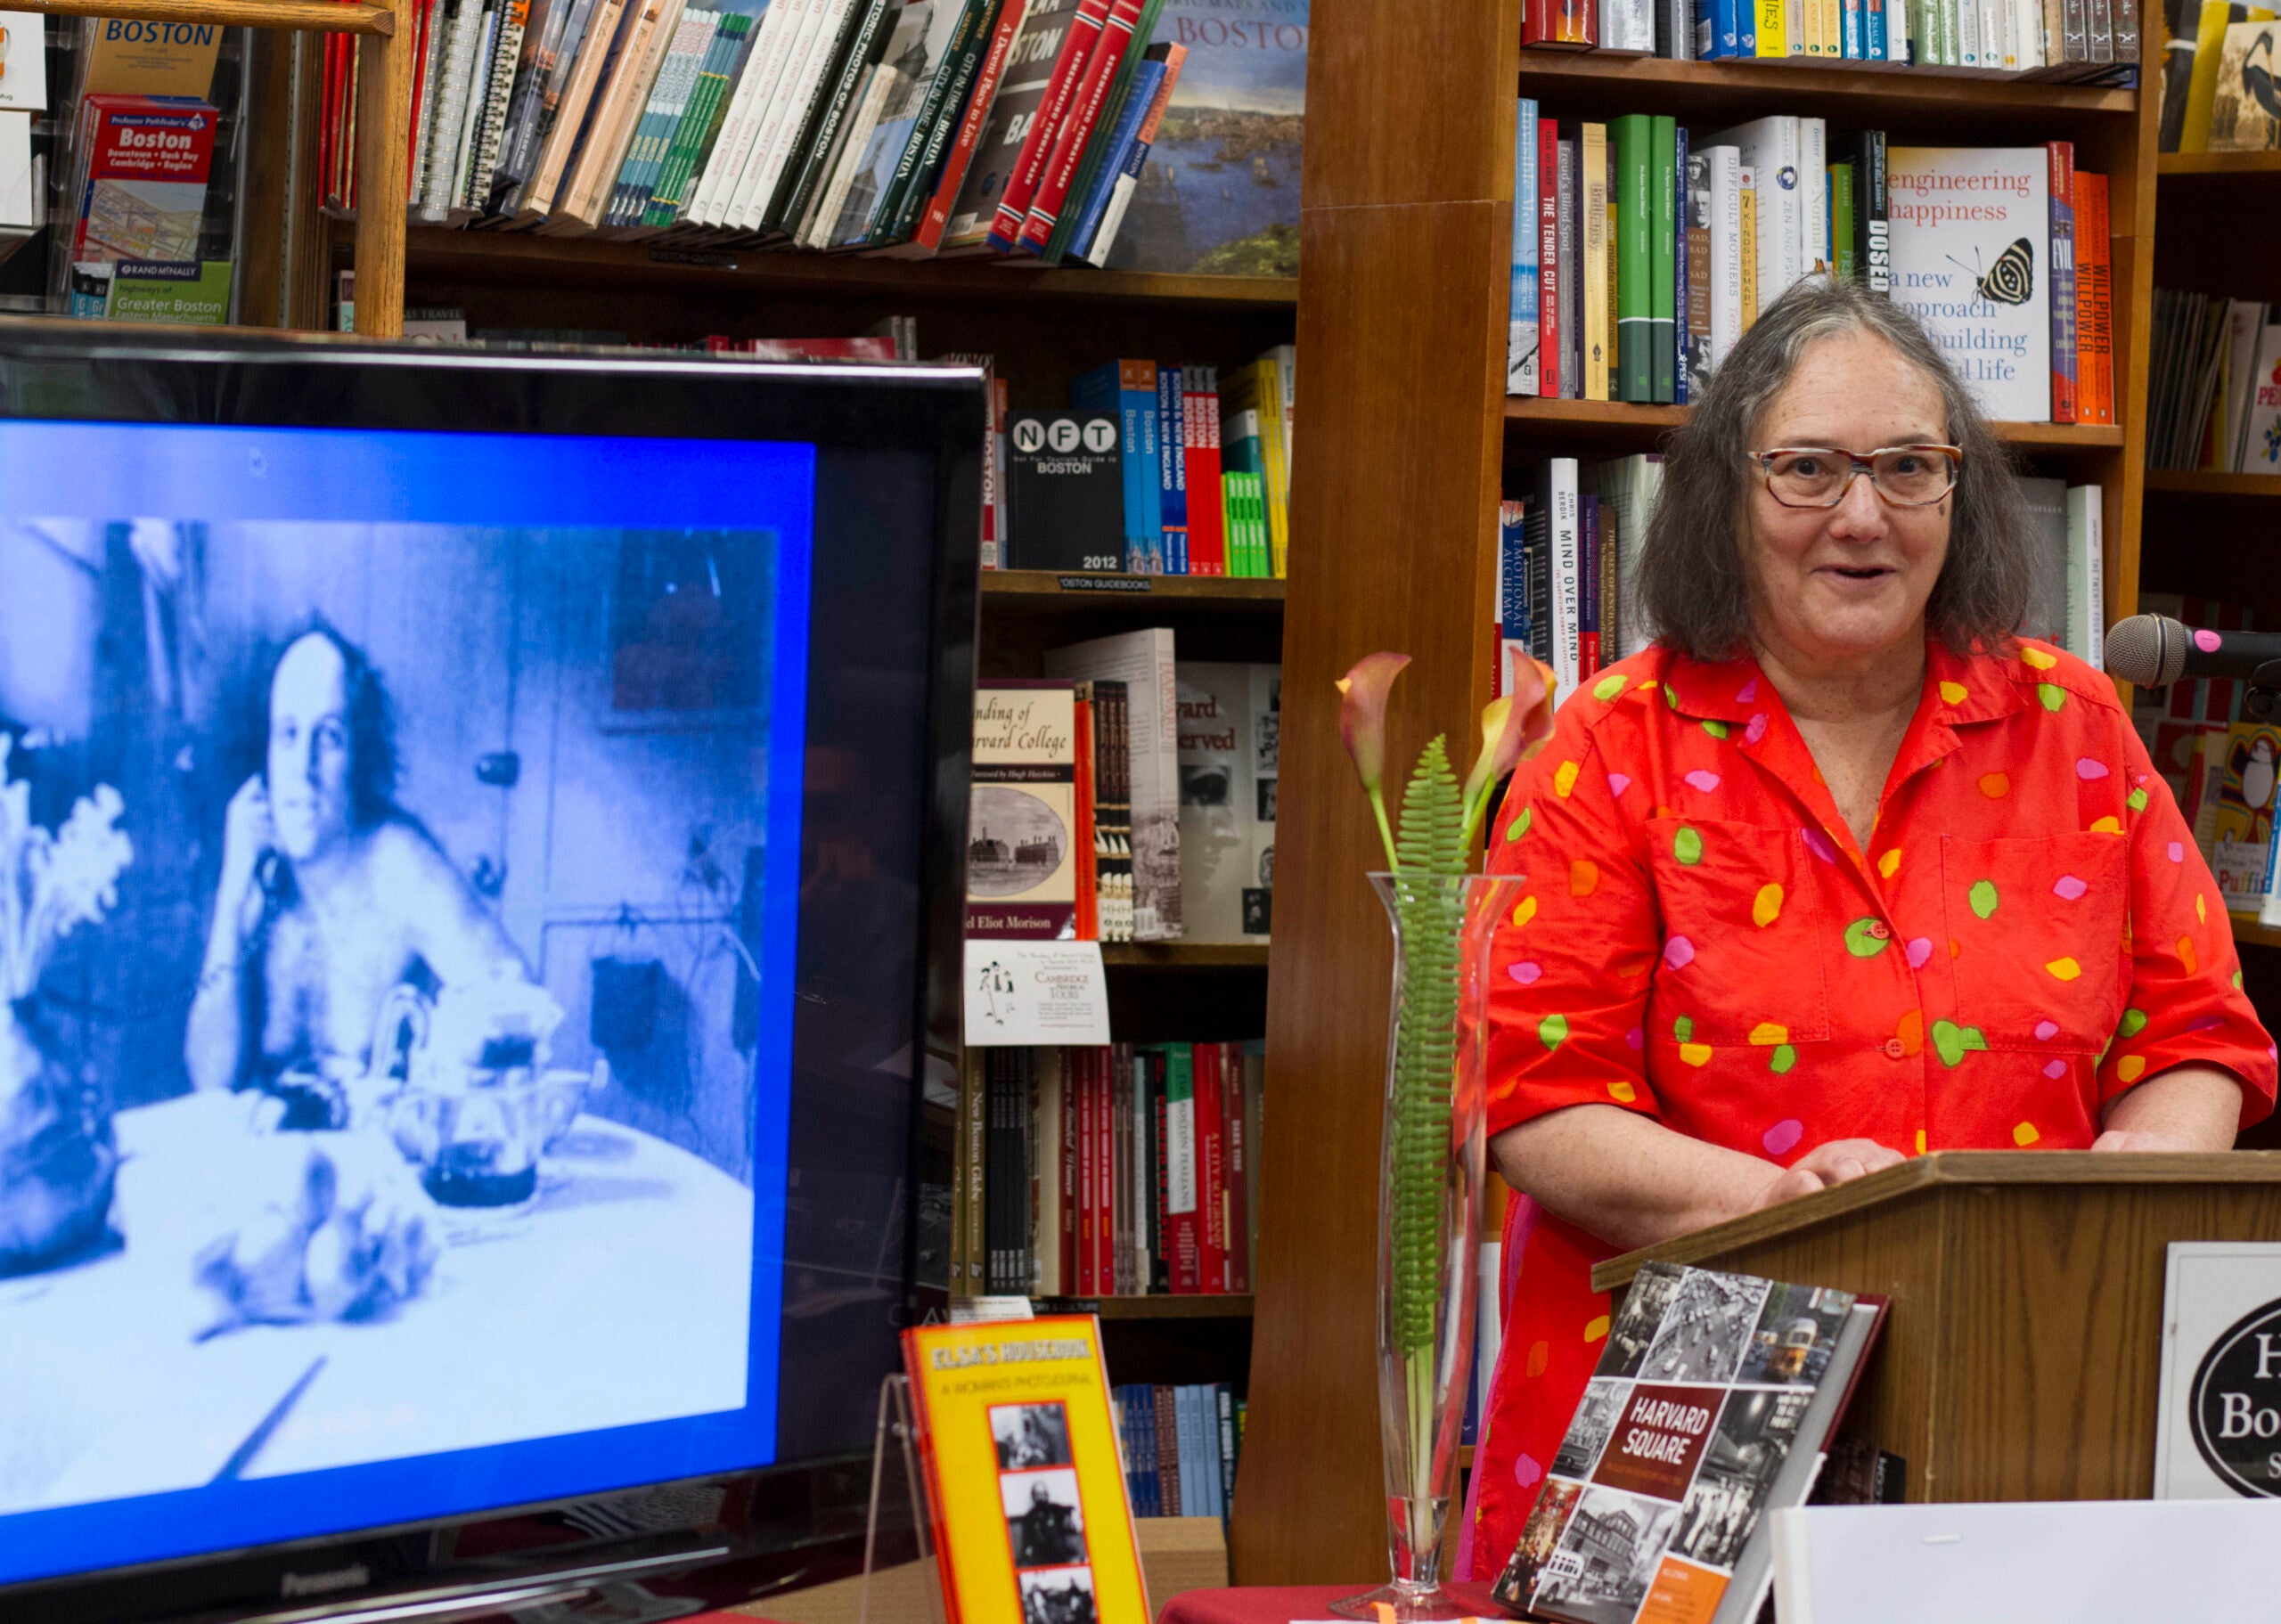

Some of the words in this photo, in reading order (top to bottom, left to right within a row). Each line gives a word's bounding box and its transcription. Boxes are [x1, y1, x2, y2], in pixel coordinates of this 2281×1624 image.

[106, 20, 214, 46] BOSTON
[951, 11, 974, 52] HANTOVER
[1001, 22, 1013, 35] A
[842, 41, 868, 90] PHOTOS
[959, 51, 977, 76] CITY
[985, 35, 1009, 76] Decent
[934, 63, 952, 88] CITY
[953, 75, 968, 89] IN
[1050, 50, 1084, 120] REMEMBERING
[1083, 53, 1117, 124] REMEMBERING
[835, 90, 848, 108] OF
[928, 87, 943, 102] IN
[944, 88, 962, 114] TIME
[973, 76, 993, 106] Place
[918, 101, 936, 127] TIME
[968, 107, 981, 121] to
[119, 127, 192, 149] Boston
[814, 110, 840, 159] BOSTON
[922, 118, 950, 168] BOSTON
[958, 121, 976, 147] Live
[1034, 120, 1055, 159] FENWAY
[1066, 124, 1088, 163] FENWAY
[1544, 130, 1553, 150] ADLER
[1812, 127, 1820, 157] Better
[107, 149, 151, 159] Downtown
[160, 151, 180, 159] Back
[182, 151, 199, 162] Bay
[895, 130, 924, 180] BOSTON
[1128, 142, 1148, 176] BOSTON
[1520, 110, 1536, 190] Invisible
[110, 158, 155, 170] Cambridge
[163, 160, 193, 172] Region
[1023, 159, 1039, 185] PARK
[1056, 163, 1072, 189] PARK
[1559, 147, 1570, 189] Freud's
[1727, 157, 1737, 228] DIFFICULT
[1887, 170, 2031, 197] engineering
[1520, 197, 1533, 234] Men
[1543, 196, 1554, 217] THE
[1559, 192, 1570, 224] Blind
[1742, 195, 1751, 208] 7
[1783, 201, 1793, 223] ZEN
[1888, 200, 2007, 227] happiness
[1742, 211, 1751, 253] KINDS
[1811, 189, 1824, 249] Normal
[1543, 223, 1554, 265] TENDER
[1559, 227, 1570, 251] Spot
[1688, 234, 1710, 243] MAD,
[1689, 247, 1707, 255] BAD
[1783, 227, 1793, 252] AND
[1729, 233, 1737, 296] MOTHERS
[1868, 219, 1889, 292] DOSED
[2052, 238, 2073, 271] EVIL
[132, 265, 157, 274] RAND
[1543, 270, 1554, 291] CUT
[1689, 272, 1707, 280] SAD
[1888, 272, 1900, 287] a
[1906, 272, 1953, 288] new
[119, 283, 160, 294] highways
[162, 285, 172, 293] of
[1742, 270, 1752, 309] SMART
[117, 296, 170, 312] Greater
[174, 298, 222, 313] Boston
[1607, 289, 1615, 349] mindfulness
[2079, 262, 2094, 353] WILLPOWER
[2095, 263, 2111, 355] WILLPOWER
[1929, 329, 2028, 356] building
[1677, 361, 1686, 379] PESI
[1978, 359, 2015, 381] life
[1158, 371, 1168, 408] BOSTON
[1173, 371, 1182, 409] BOSTON
[1160, 410, 1169, 419] &
[1173, 411, 1182, 419] &
[1182, 396, 1194, 447] BOSTON
[1195, 396, 1206, 448] BOSTON
[1207, 397, 1219, 449] BOSTON
[1125, 409, 1137, 453] Boston
[1143, 410, 1157, 454] Boston
[1160, 420, 1170, 443] NEW
[1174, 421, 1183, 444] NEW
[982, 430, 993, 504] BOSTON
[1037, 462, 1091, 474] BOSTON
[1161, 445, 1172, 490] ENGLAND
[1175, 445, 1185, 490] ENGLAND
[1557, 490, 1566, 520] BERDIK
[1559, 529, 1573, 569] MIND
[1606, 528, 1615, 550] THE
[1083, 556, 1117, 568] 2012
[1606, 551, 1615, 573] USES
[2091, 558, 2099, 573] THE
[1094, 578, 1150, 590] GUIDEBOOKS
[1501, 547, 1513, 620] ALCHEMY
[1513, 539, 1523, 629] EMOTIONAL
[1563, 575, 1576, 616] OVER
[1607, 575, 1615, 589] OF
[2092, 576, 2100, 608] TWENTY
[2092, 611, 2100, 632] FOUR
[1566, 621, 1580, 662] MIND
[2093, 637, 2101, 657] HOUR
[1018, 701, 1034, 730] of
[1018, 723, 1067, 759] College
[978, 916, 1003, 928] Eliot
[1007, 916, 1051, 928] Morison
[1034, 971, 1089, 984] CAMBRIDGE
[1049, 988, 1079, 1000] TOURS
[971, 1091, 982, 1117] New
[1177, 1101, 1187, 1149] BOSTON
[1211, 1131, 1219, 1140] A
[970, 1121, 983, 1163] Boston
[1211, 1143, 1220, 1176] CITY
[970, 1165, 983, 1202] Globe
[1178, 1152, 1188, 1207] ITALIANS
[931, 1342, 998, 1371] ELSA'S
[1629, 1395, 1710, 1435] HARVARD
[1622, 1427, 1691, 1465] SQUARE
